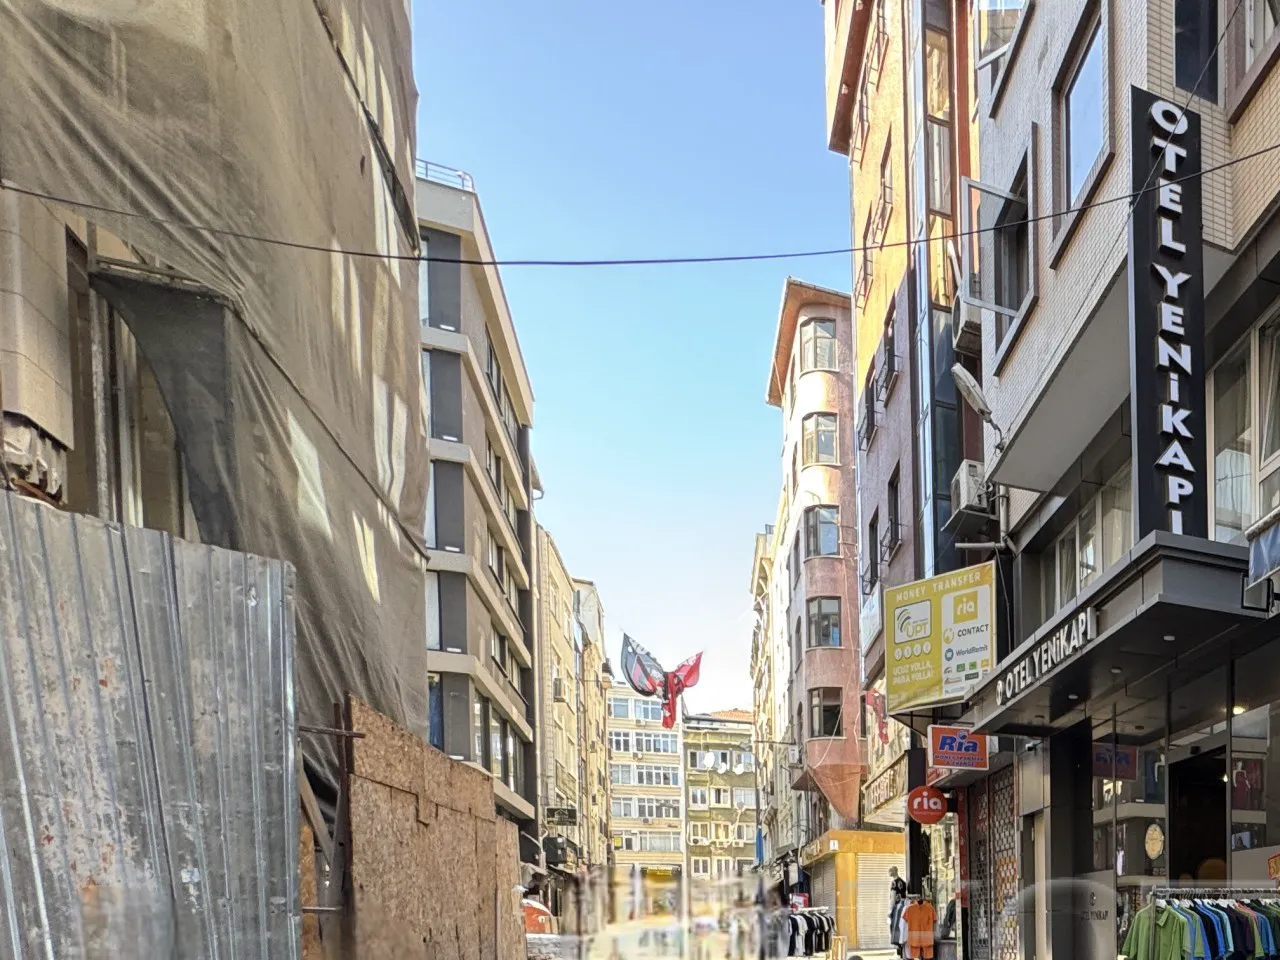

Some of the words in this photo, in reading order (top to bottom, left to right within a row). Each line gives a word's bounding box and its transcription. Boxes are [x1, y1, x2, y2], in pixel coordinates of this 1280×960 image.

[1151, 100, 1189, 254] OTEL
[896, 586, 926, 602] MONEY
[932, 572, 981, 592] TRANSFER
[956, 597, 974, 616] ria
[906, 622, 929, 637] UPT
[957, 624, 989, 637] CONTACT
[1005, 657, 1032, 699] OTEL
[938, 730, 979, 753] Ria
[913, 791, 942, 810] ria
